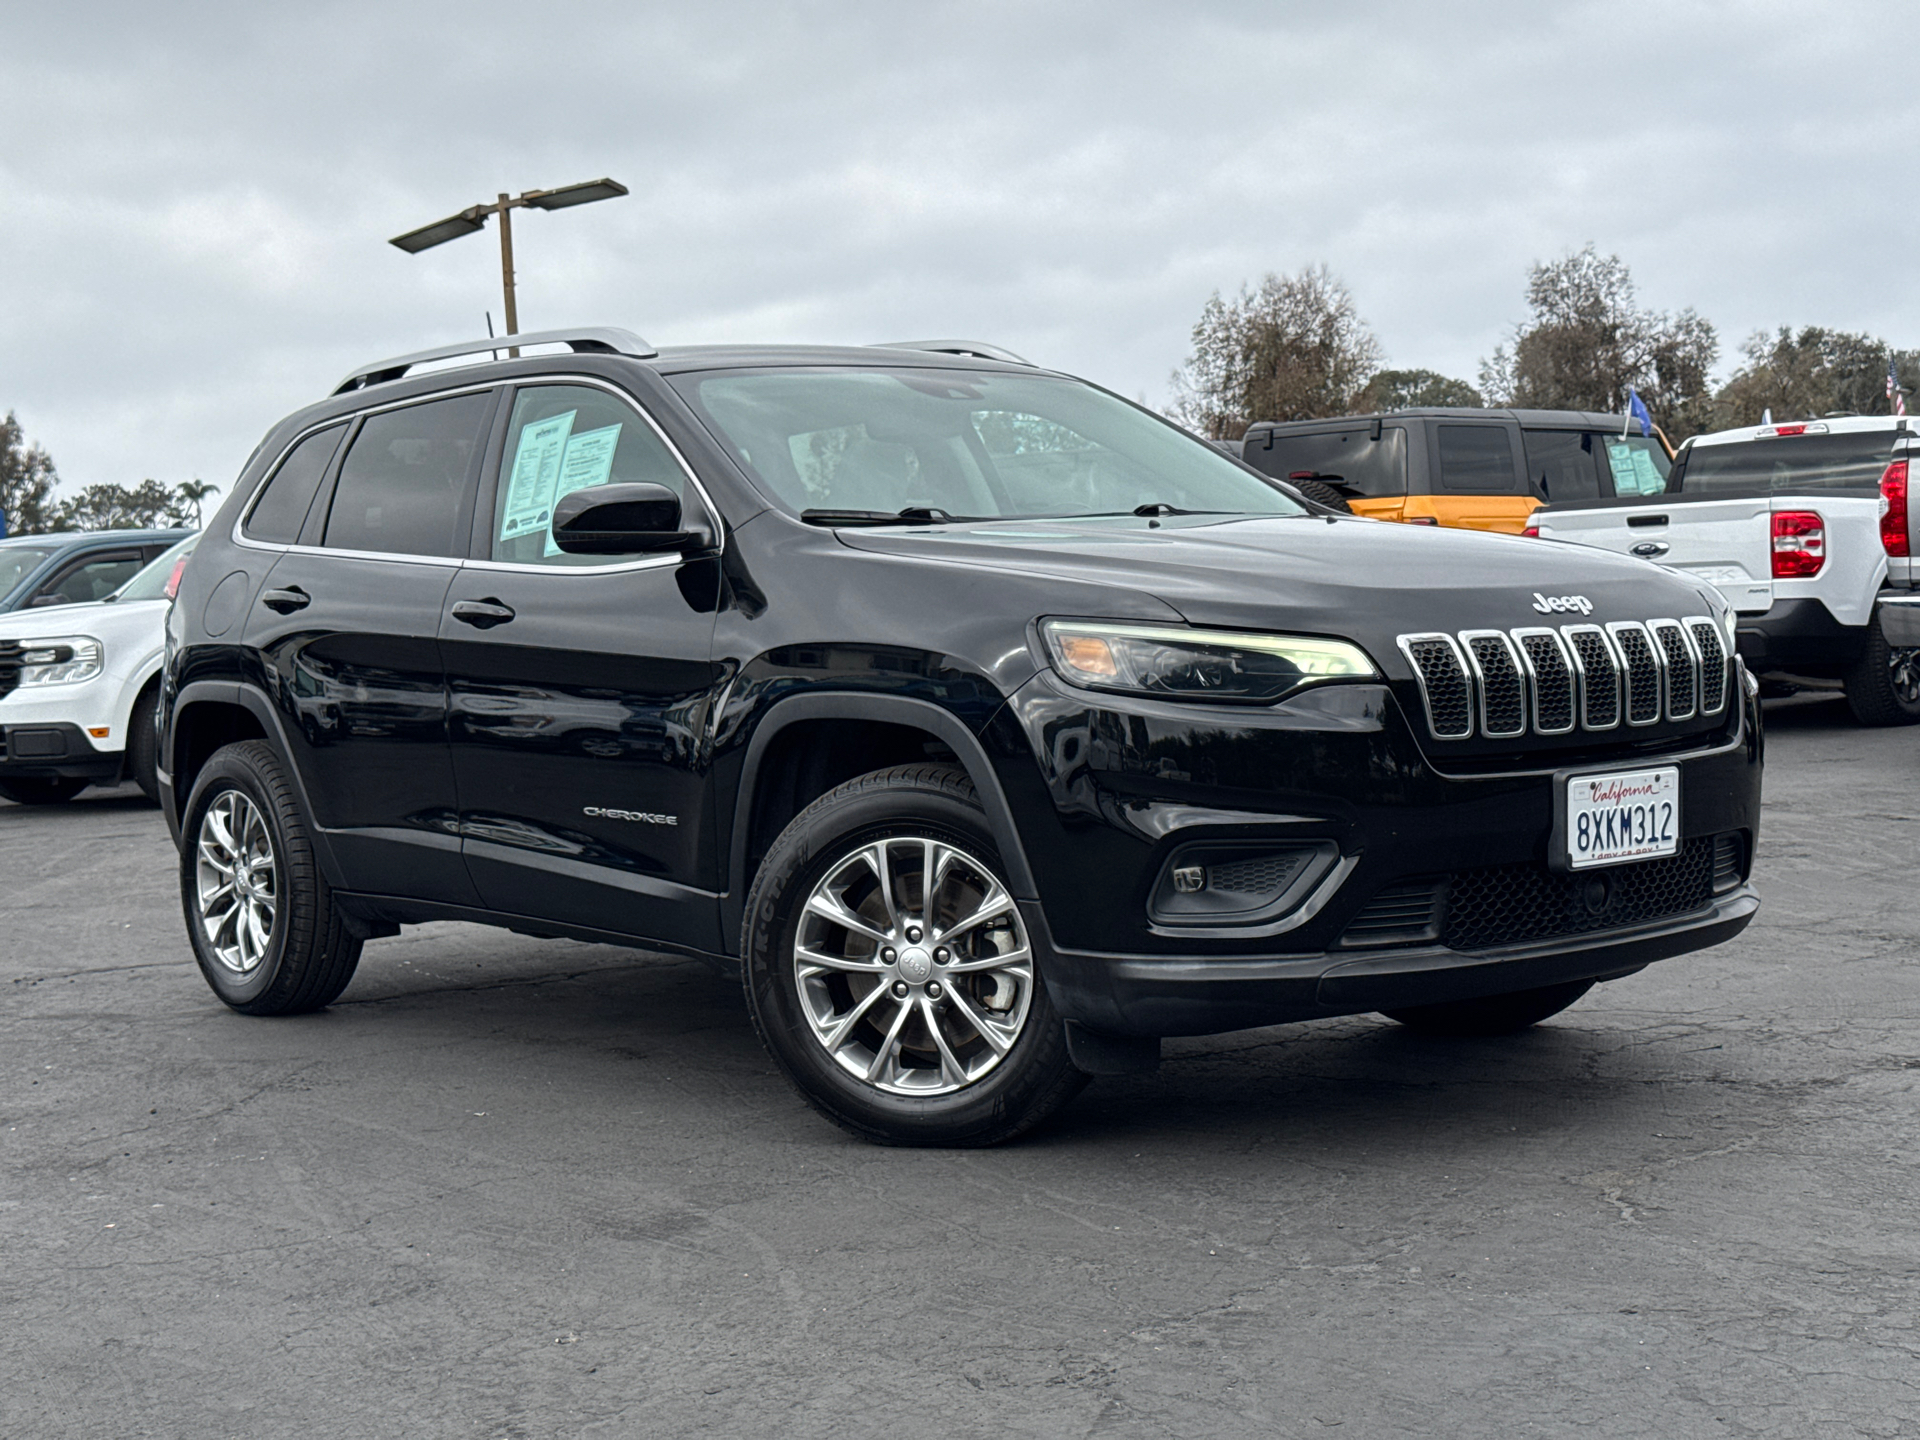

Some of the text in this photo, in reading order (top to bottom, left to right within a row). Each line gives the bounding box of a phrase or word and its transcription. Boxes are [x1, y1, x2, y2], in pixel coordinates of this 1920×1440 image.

[1532, 592, 1593, 616] Jeep
[1592, 780, 1660, 806] California
[583, 806, 678, 826] CHEROKEE
[1577, 802, 1672, 852] 8XKM312
[1597, 846, 1654, 860] dmv.ca.gov
[903, 955, 926, 976] Jeep
